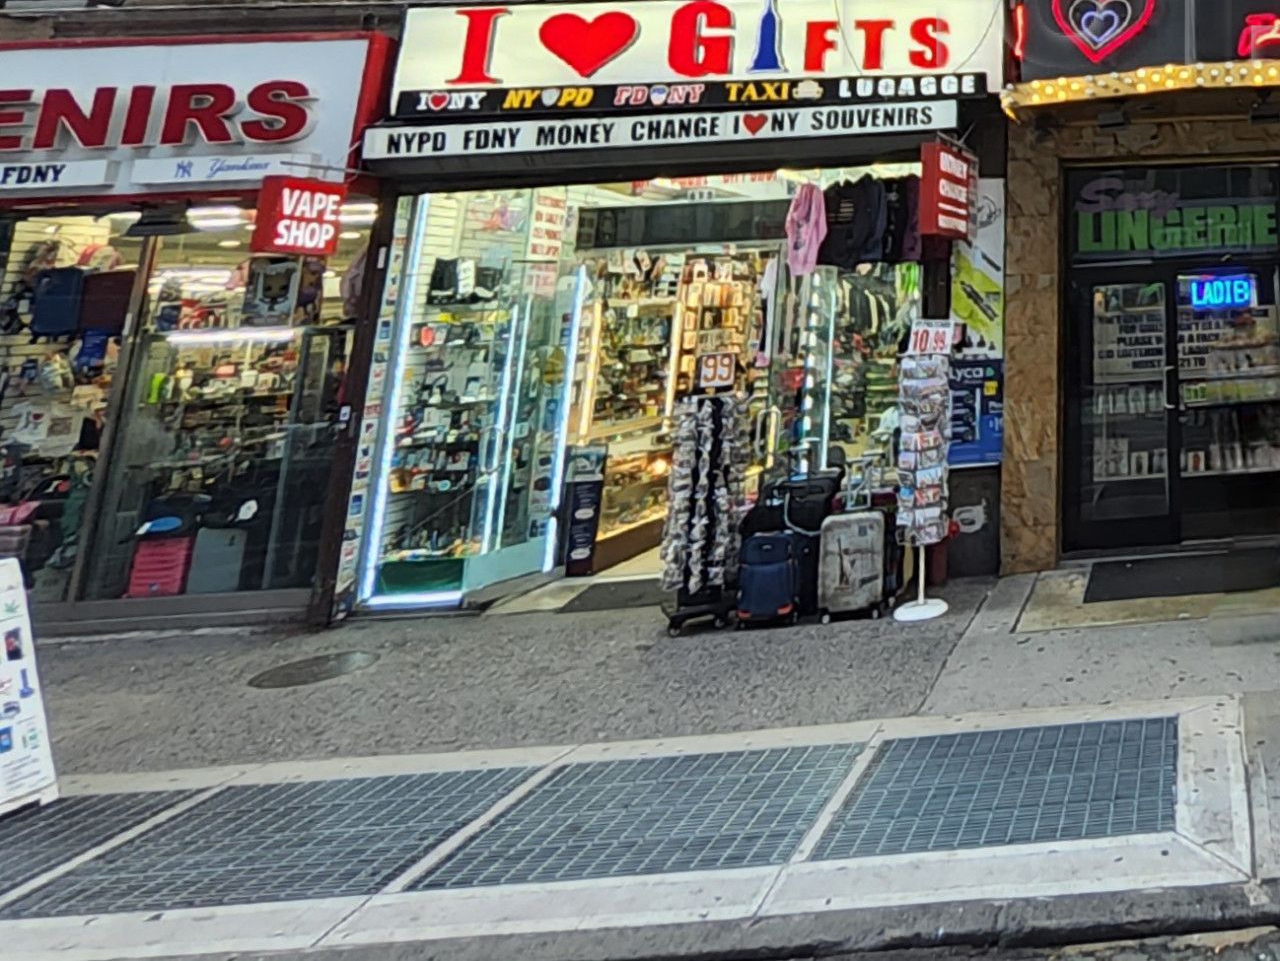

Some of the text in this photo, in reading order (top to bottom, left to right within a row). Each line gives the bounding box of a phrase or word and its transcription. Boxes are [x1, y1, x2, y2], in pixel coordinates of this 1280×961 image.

[445, 7, 508, 85] I
[725, 81, 791, 102] TAXI
[387, 130, 447, 154] NYPD
[463, 127, 520, 151] FDNY
[536, 122, 614, 147] MONEY
[630, 116, 720, 143] CHANGE
[810, 105, 934, 132] SOUVENIRS
[1, 163, 67, 185] FDNY
[281, 187, 341, 220] VAPE
[274, 218, 335, 249] SHOP
[1078, 203, 1279, 252] LINGERIE
